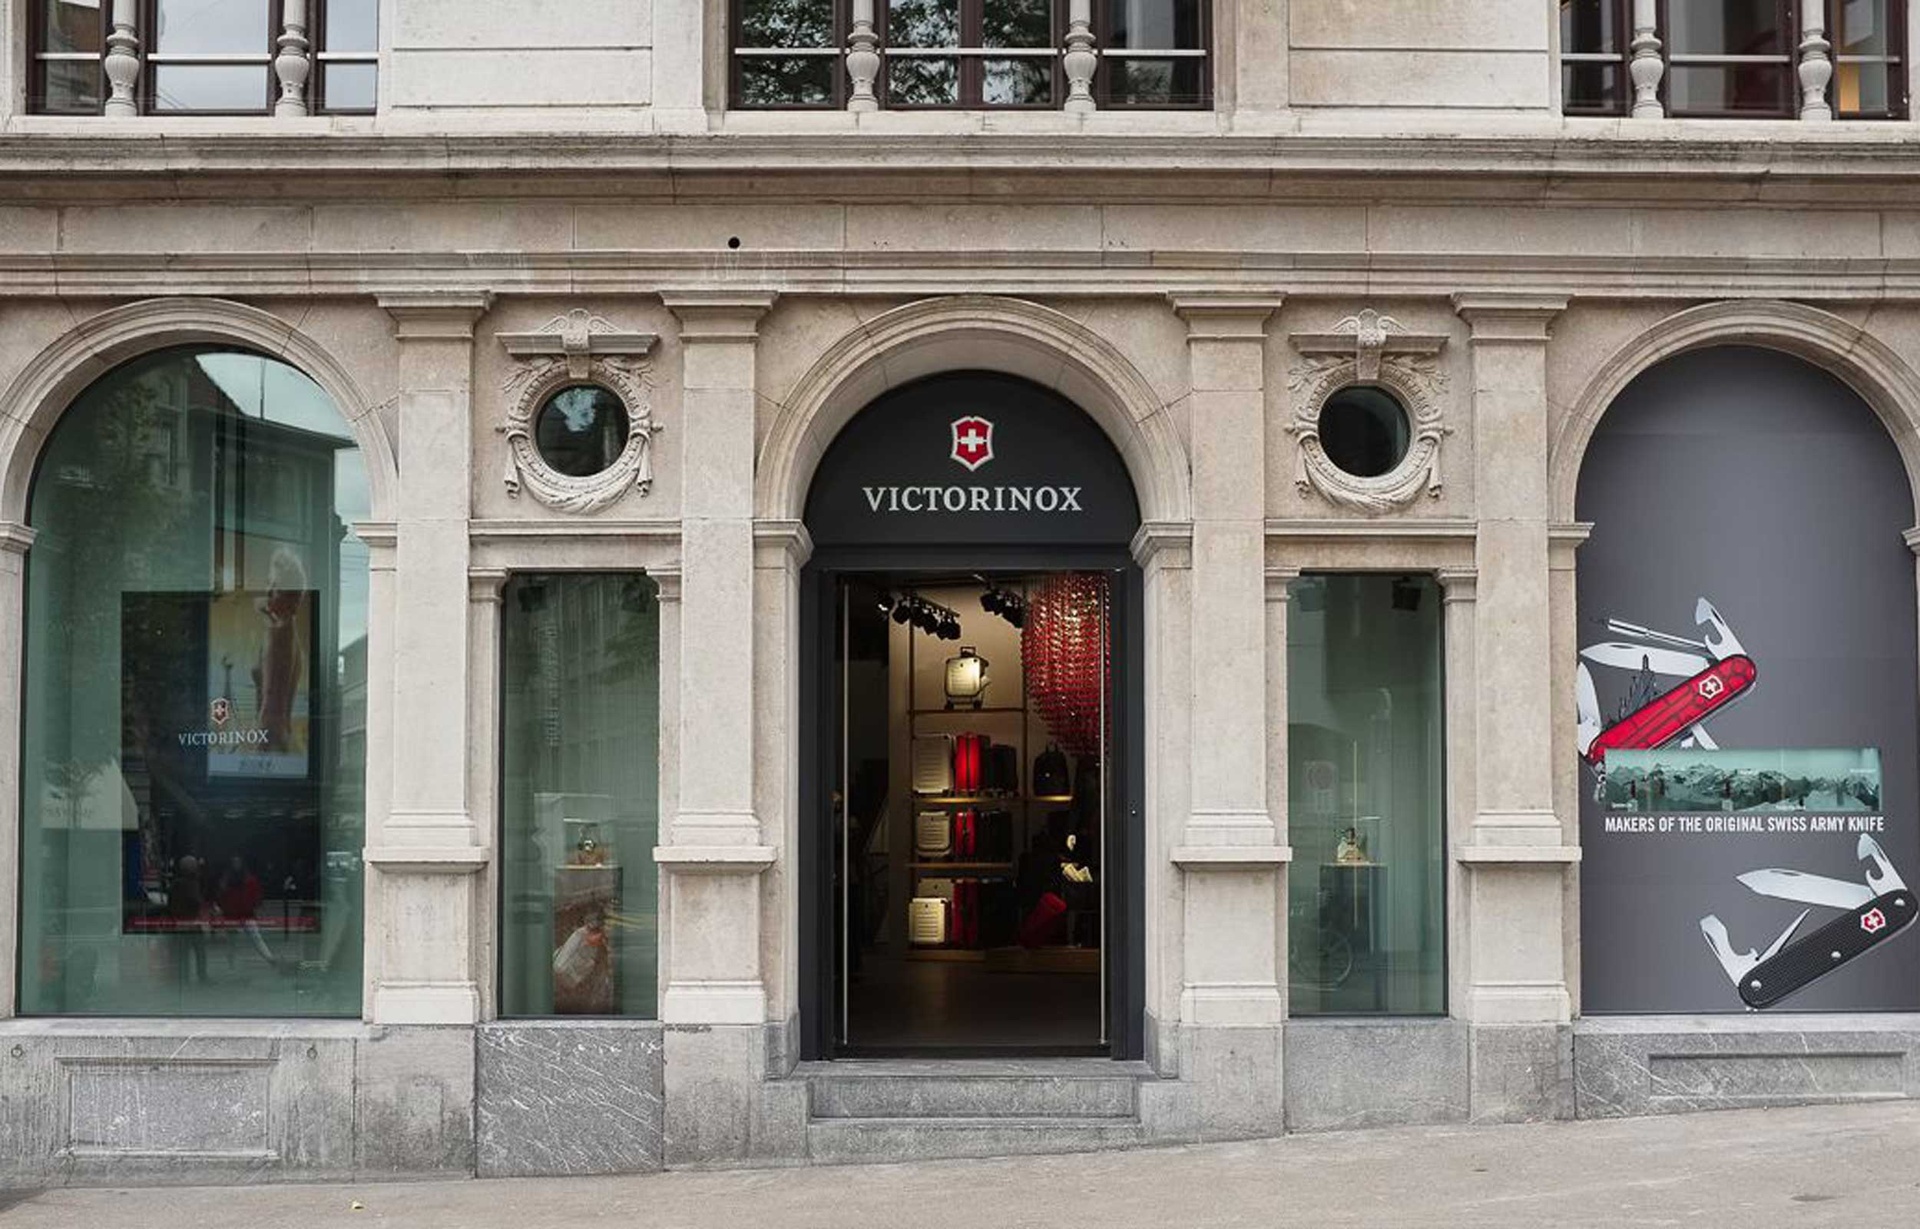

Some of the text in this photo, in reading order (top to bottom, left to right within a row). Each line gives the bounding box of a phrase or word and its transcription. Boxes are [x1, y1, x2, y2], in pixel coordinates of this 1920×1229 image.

[862, 486, 1082, 512] VICTORINOX
[178, 729, 269, 746] VICTORINOX
[1604, 816, 1884, 832] MAKERS OF THE ORIGINAL SWISS ARMY KNIFE
